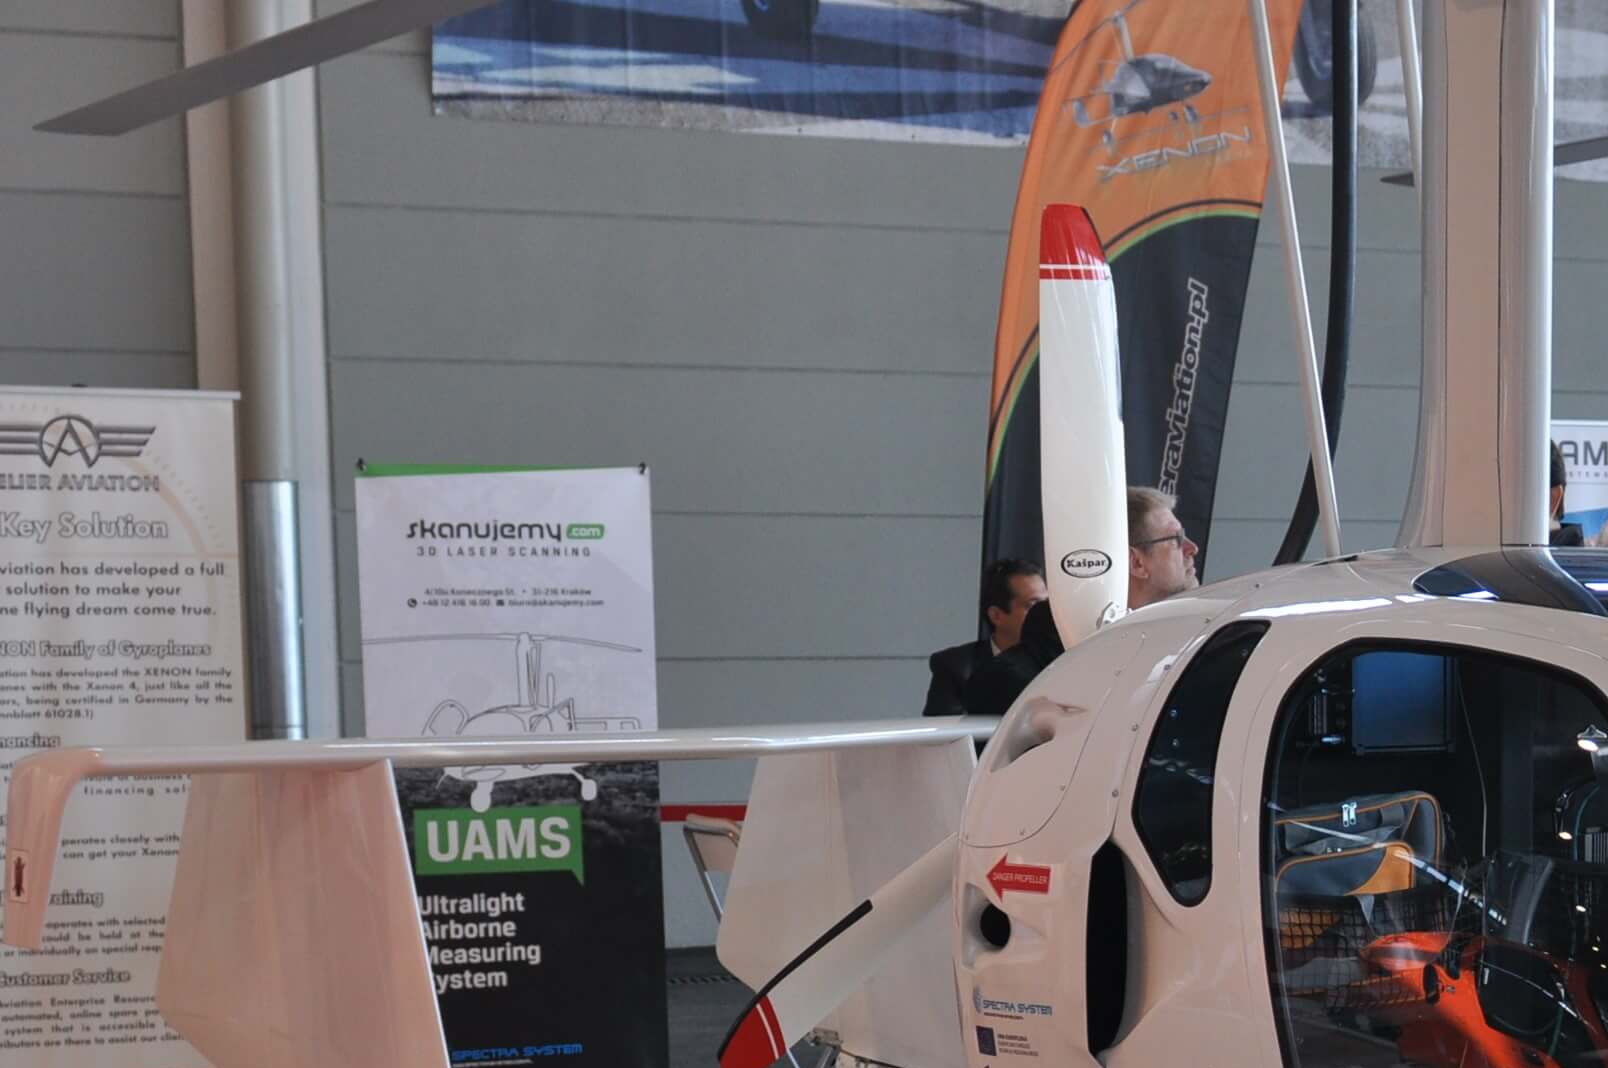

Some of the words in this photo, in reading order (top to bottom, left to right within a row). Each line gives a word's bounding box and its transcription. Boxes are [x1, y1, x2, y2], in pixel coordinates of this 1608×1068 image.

[1096, 125, 1252, 182] XENON
[57, 474, 160, 492] AVIATION
[0, 510, 51, 545] Key
[57, 511, 169, 540] Solution
[417, 547, 437, 557] 3D
[447, 546, 498, 557] LASER
[508, 546, 592, 558] SCANNING
[60, 561, 89, 576] has
[93, 562, 180, 579] developed
[184, 566, 195, 577] a
[199, 562, 225, 576] full
[5, 583, 70, 597] solution
[74, 583, 91, 596] to
[95, 583, 141, 597] make
[145, 585, 182, 600] your
[23, 602, 71, 620] flying
[75, 602, 129, 617] dream
[133, 606, 177, 617] come
[181, 604, 217, 617] true.
[31, 667, 52, 678] has
[55, 667, 119, 681] developed
[122, 667, 140, 678] the
[144, 667, 192, 678] XENON
[195, 667, 232, 680] family
[32, 681, 57, 691] with
[62, 681, 81, 691] the
[86, 681, 124, 691] Xenon
[144, 681, 166, 693] just
[214, 680, 233, 690] the
[26, 696, 60, 708] being
[134, 695, 190, 707] Germany
[426, 816, 572, 863] UAMS
[418, 892, 526, 918] Ultralight
[983, 999, 1016, 1013] SPECTRA
[1018, 1003, 1053, 1017] SYSTEM
